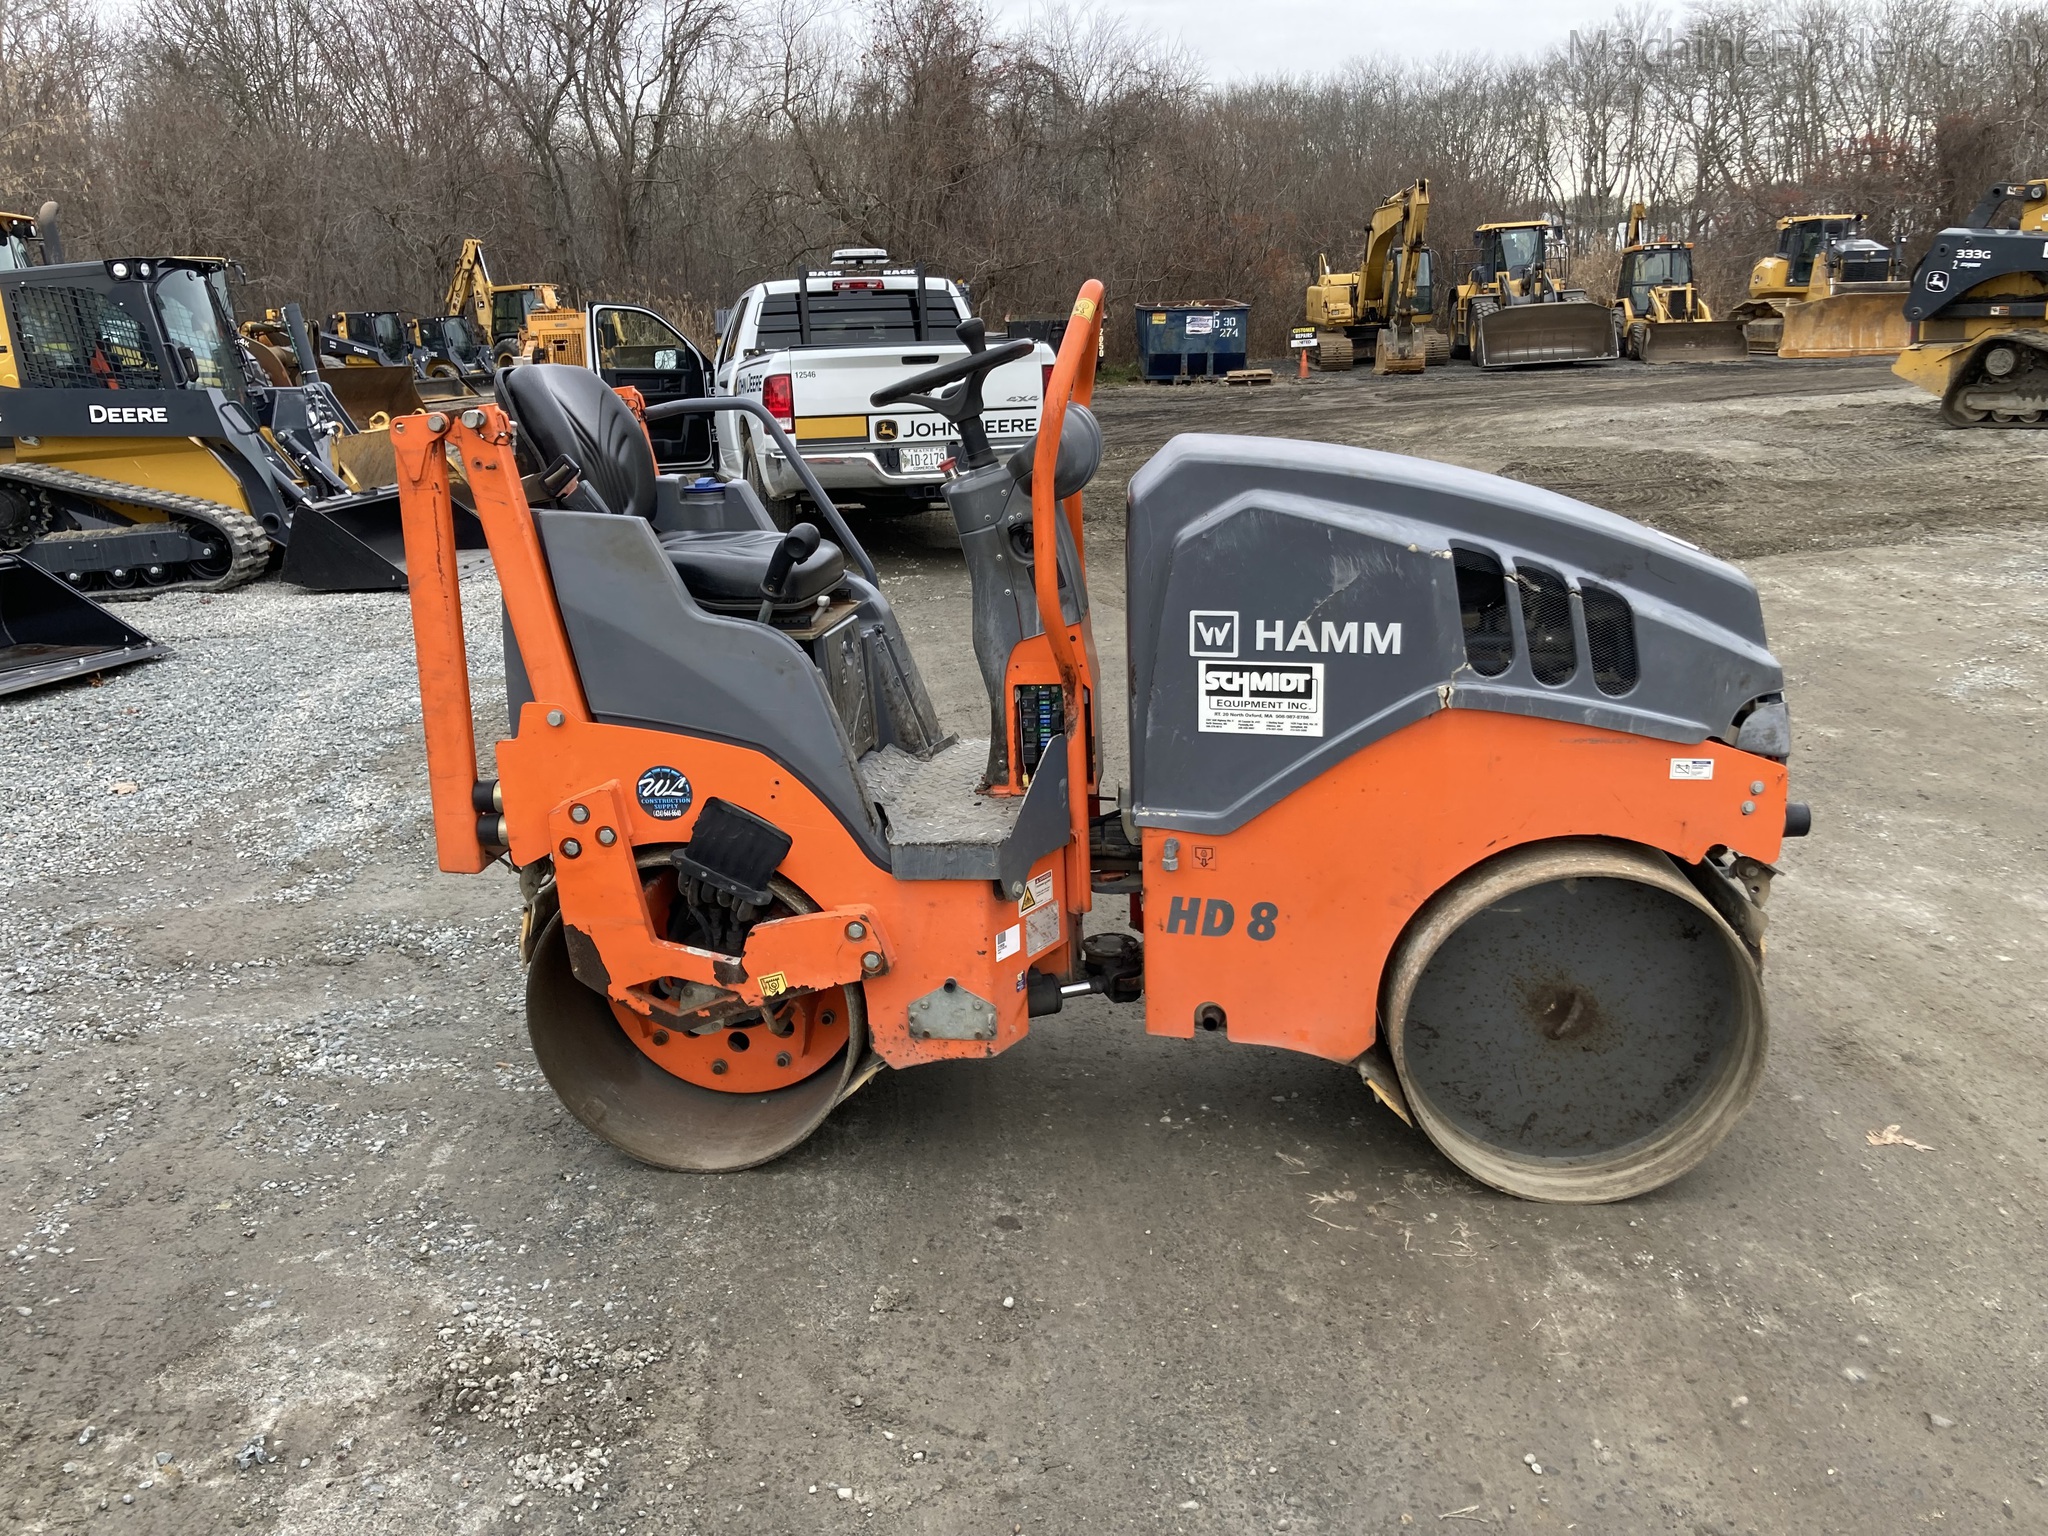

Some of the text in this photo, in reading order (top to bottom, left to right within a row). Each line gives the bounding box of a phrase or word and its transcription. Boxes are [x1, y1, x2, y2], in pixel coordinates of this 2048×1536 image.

[1955, 249, 1992, 259] 333G
[1952, 260, 1958, 270] 2
[1223, 317, 1236, 326] 30
[1220, 328, 1239, 337] 274
[353, 346, 369, 355] DEERE
[795, 371, 816, 379] 12546
[88, 404, 168, 423] DEERE
[985, 418, 1037, 434] EERE
[1255, 620, 1402, 655] HAMM
[1205, 671, 1311, 697] SCHMIDT
[1216, 699, 1311, 711] EQUIPMENT INC.
[1166, 896, 1279, 942] HD 8
